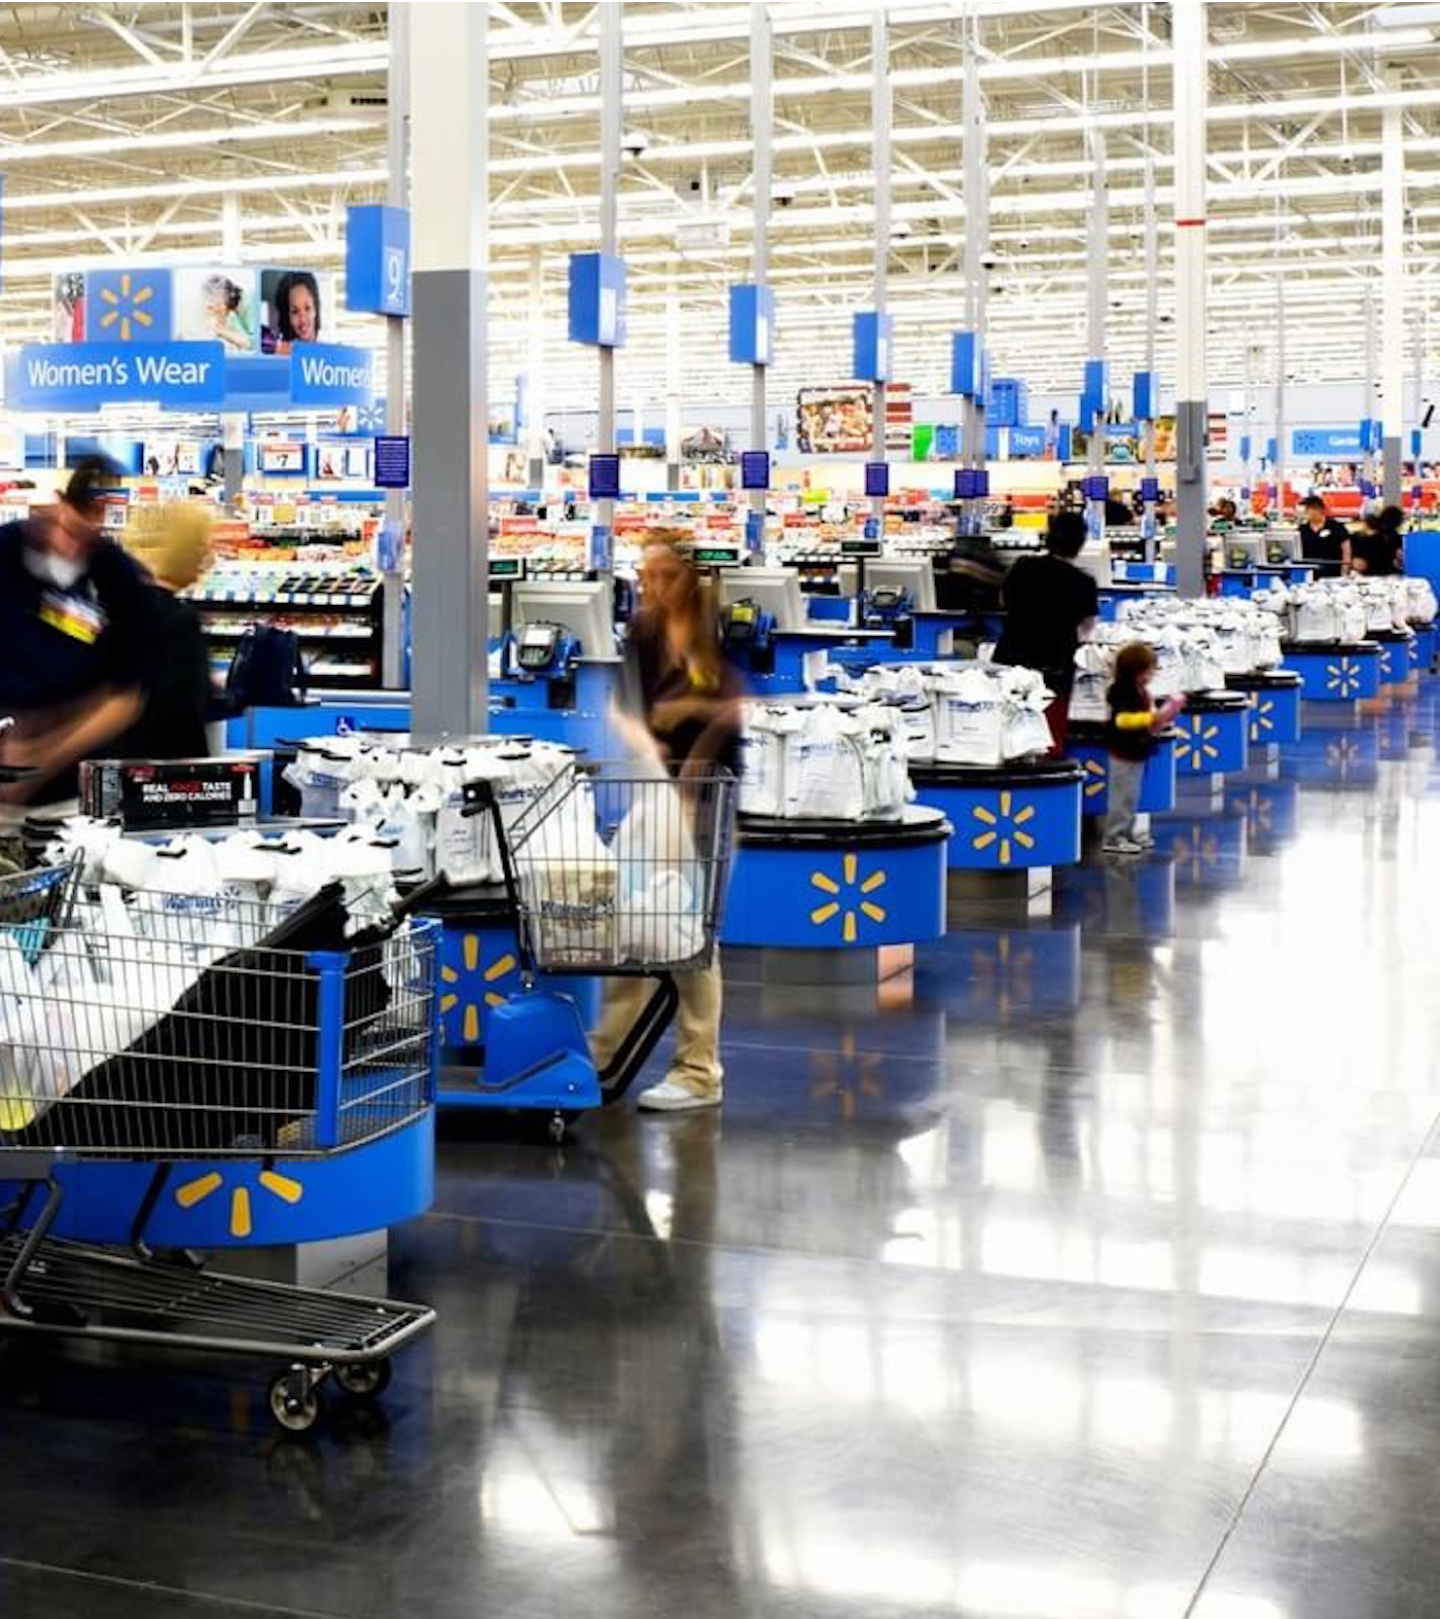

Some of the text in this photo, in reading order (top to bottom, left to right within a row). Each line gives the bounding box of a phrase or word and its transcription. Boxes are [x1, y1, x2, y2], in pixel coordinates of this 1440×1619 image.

[28, 357, 211, 388] Women's Wear
[143, 783, 169, 793] REAL
[202, 781, 231, 792] TASTE
